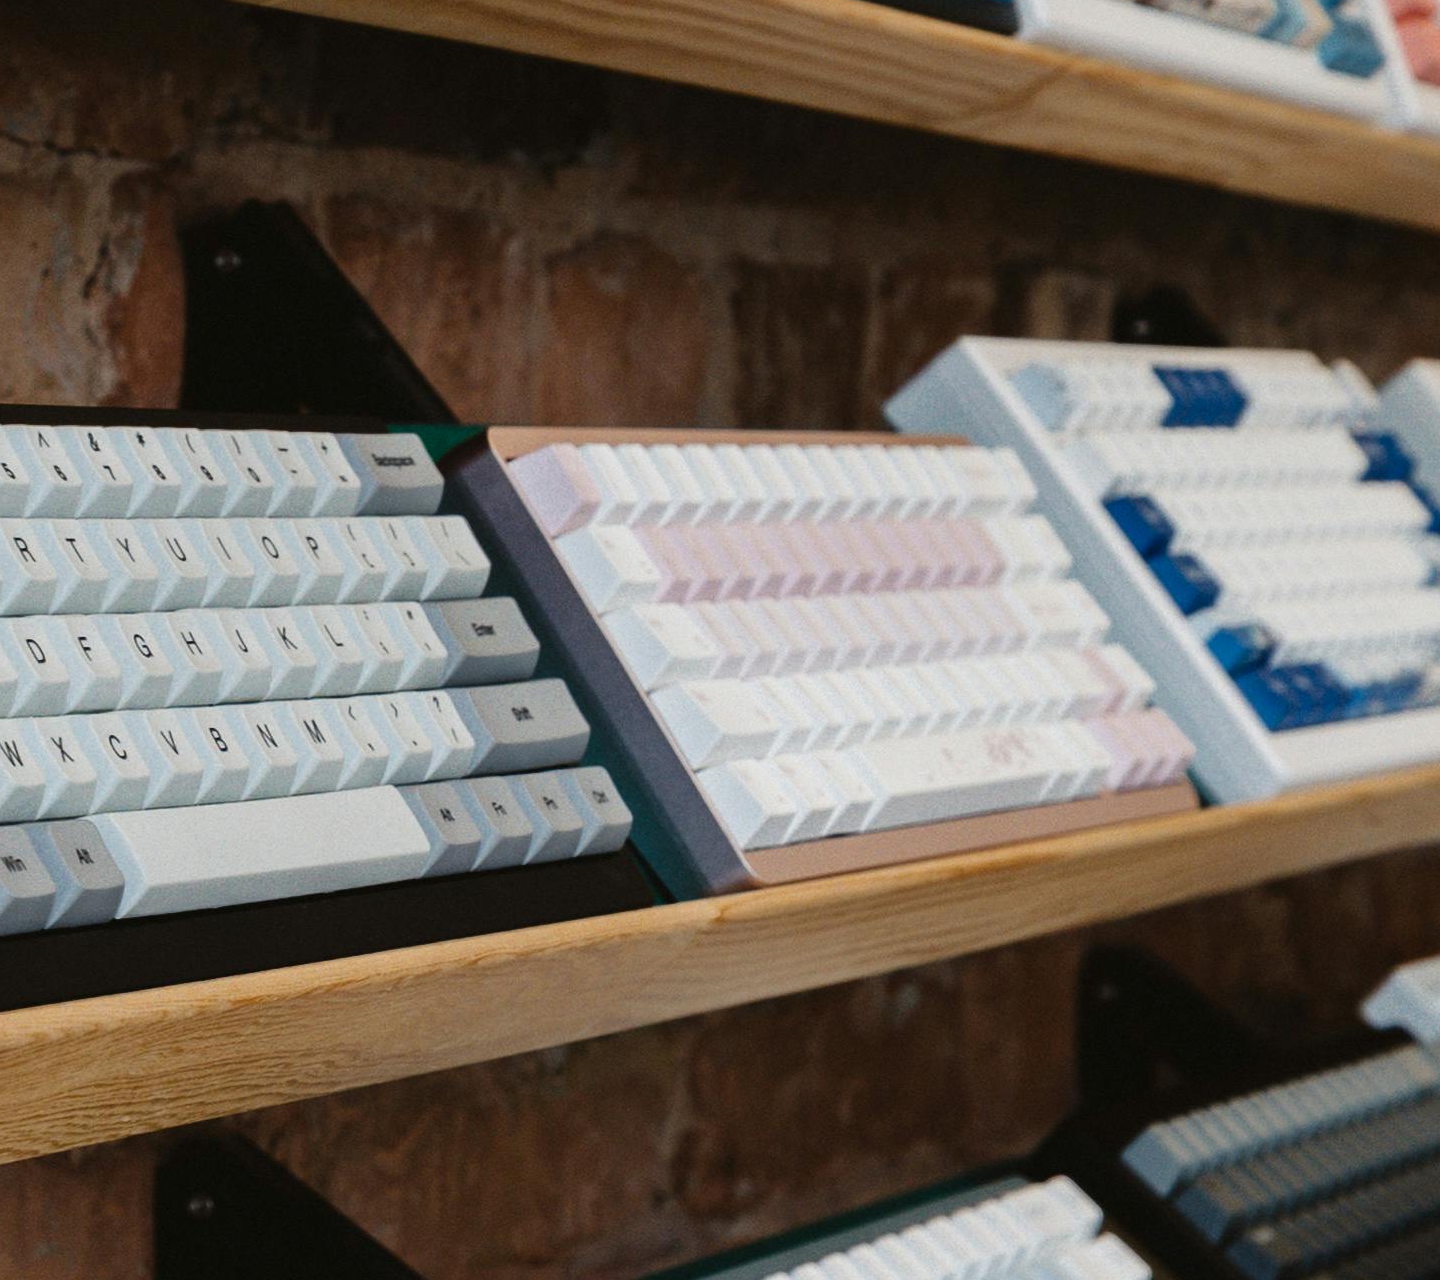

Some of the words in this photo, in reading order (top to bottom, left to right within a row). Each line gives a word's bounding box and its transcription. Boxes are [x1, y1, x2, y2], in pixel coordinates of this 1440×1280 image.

[0, 462, 17, 480] 5
[102, 464, 116, 480] 7
[13, 536, 36, 562] R
[65, 537, 84, 562] T
[116, 538, 135, 562] Y
[166, 538, 188, 563] U
[261, 535, 280, 560] O
[305, 535, 319, 555] P
[77, 635, 92, 654] F
[133, 633, 154, 659] G
[182, 632, 202, 654] H
[235, 630, 249, 654] J
[277, 627, 298, 650] K
[324, 625, 344, 648] L
[25, 638, 47, 665] D
[511, 706, 533, 722] Shift
[160, 730, 180, 755] V
[208, 726, 229, 753] B
[256, 724, 279, 748] N
[303, 719, 326, 744] M
[51, 737, 75, 762] X
[108, 734, 128, 761] C
[1, 855, 26, 872] Win
